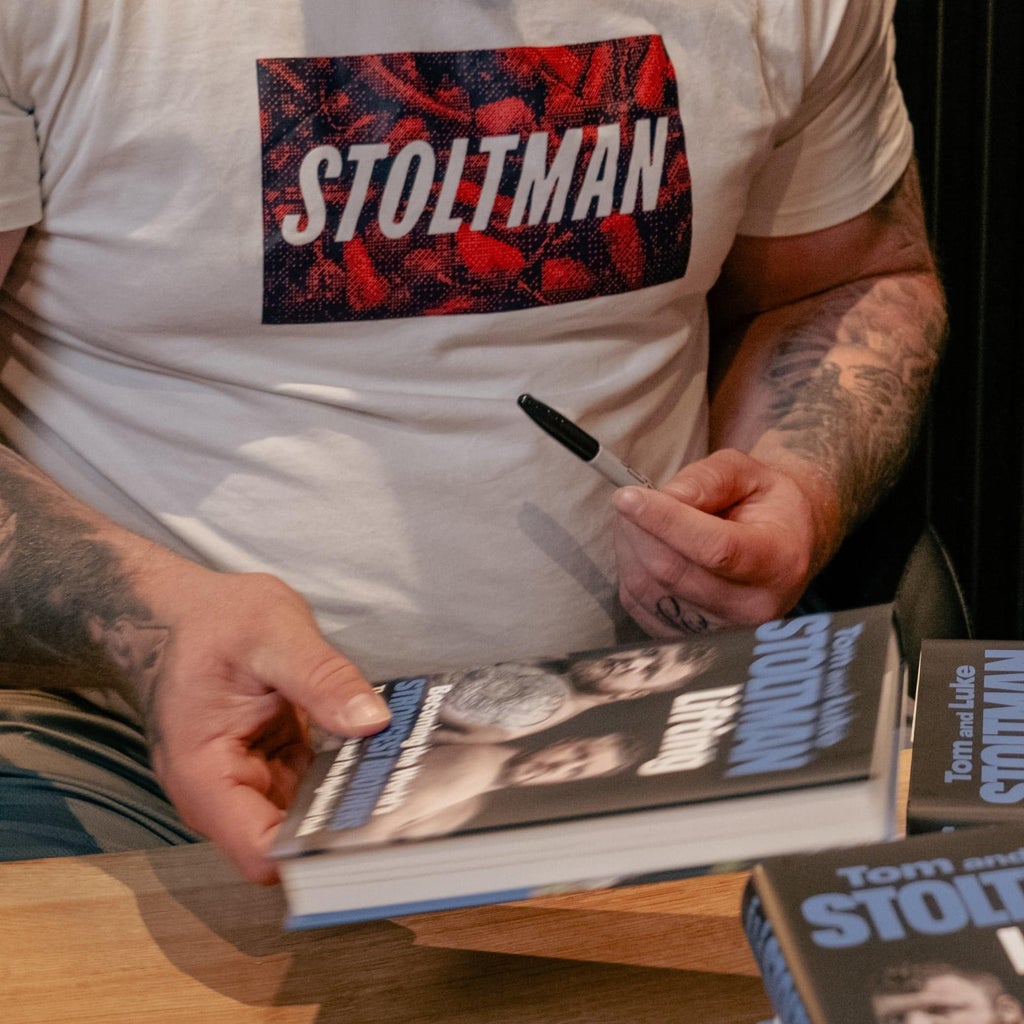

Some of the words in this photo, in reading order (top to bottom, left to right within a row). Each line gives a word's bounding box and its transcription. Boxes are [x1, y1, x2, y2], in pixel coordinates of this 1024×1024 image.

[281, 116, 669, 246] STOLTMAN
[724, 613, 832, 778] STOLTMAN
[948, 665, 976, 709] Luke
[637, 683, 745, 776] Lifting
[956, 712, 974, 738] and
[944, 740, 973, 783] Tom
[835, 857, 955, 888] Tom
